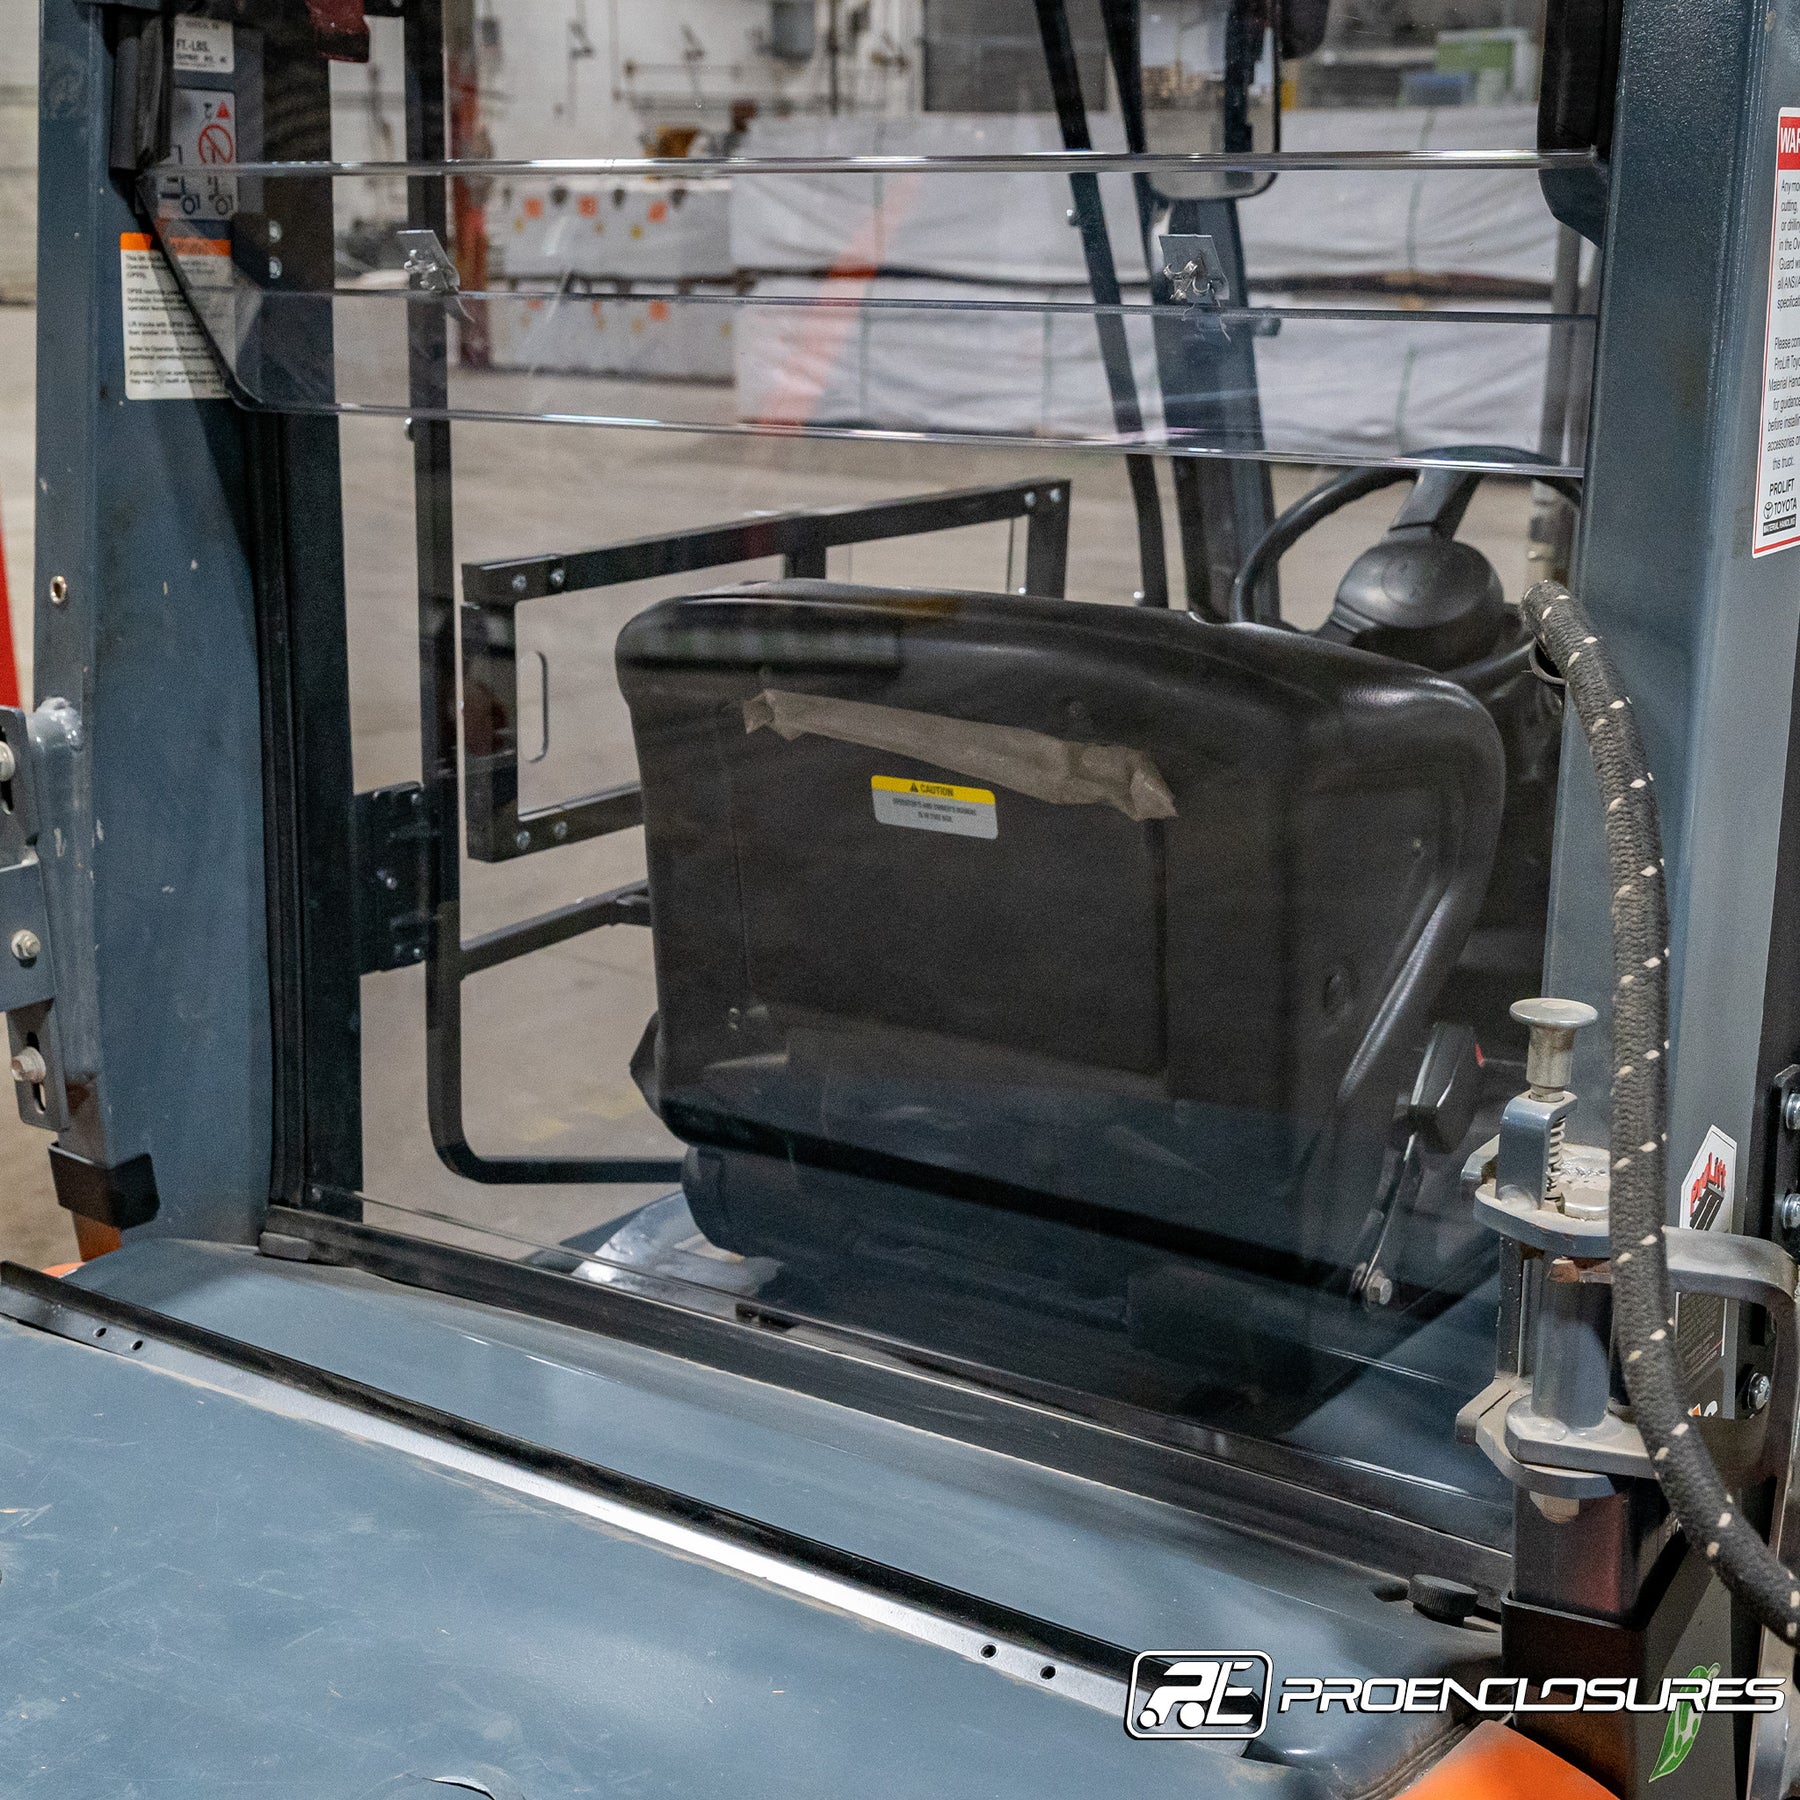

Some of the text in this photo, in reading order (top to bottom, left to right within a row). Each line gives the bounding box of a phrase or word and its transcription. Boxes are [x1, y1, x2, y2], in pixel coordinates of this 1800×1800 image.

[1769, 478, 1795, 497] PROLIFT
[1774, 497, 1797, 515] TOYOTA
[920, 784, 954, 796] CAUTION
[1689, 1152, 1727, 1218] ProLift
